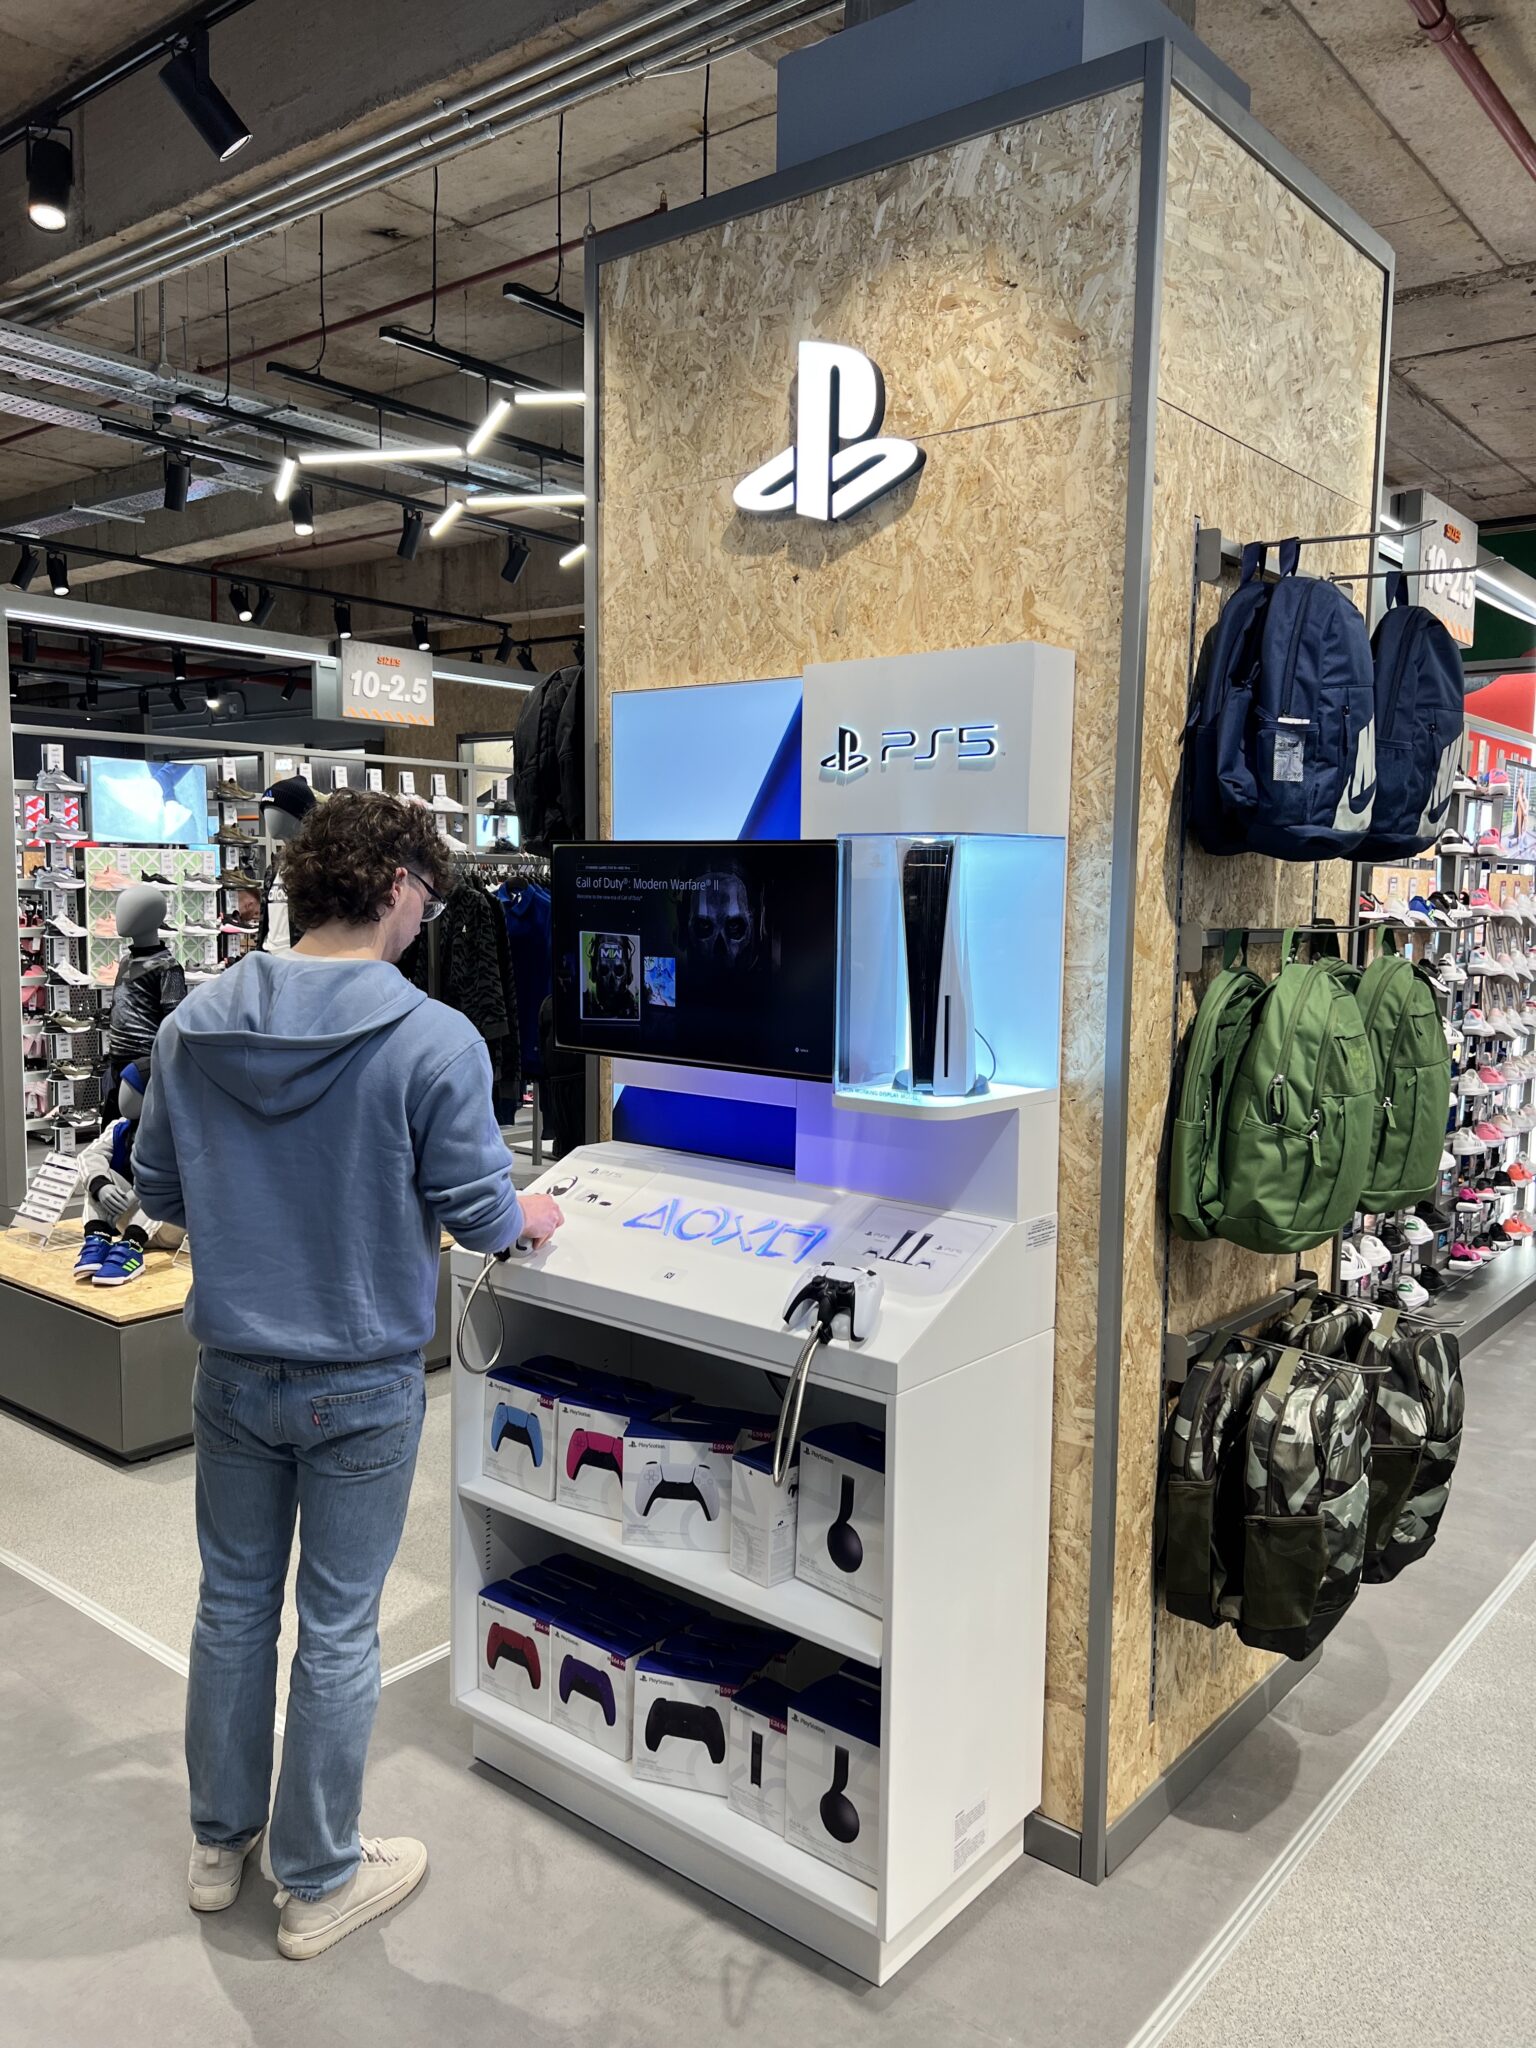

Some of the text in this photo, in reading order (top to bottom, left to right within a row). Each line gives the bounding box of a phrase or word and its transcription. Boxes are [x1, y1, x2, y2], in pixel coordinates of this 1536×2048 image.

[376, 655, 400, 667] SIZES
[350, 669, 428, 705] 10-2.5
[881, 724, 998, 763] PS5
[576, 876, 591, 888] Call
[593, 877, 602, 888] of
[633, 878, 669, 890] Modern
[569, 1408, 591, 1418] PlayStation
[811, 1450, 834, 1464] PlayStation
[649, 1677, 674, 1687] PlayStation
[800, 1717, 826, 1734] PlayStation
